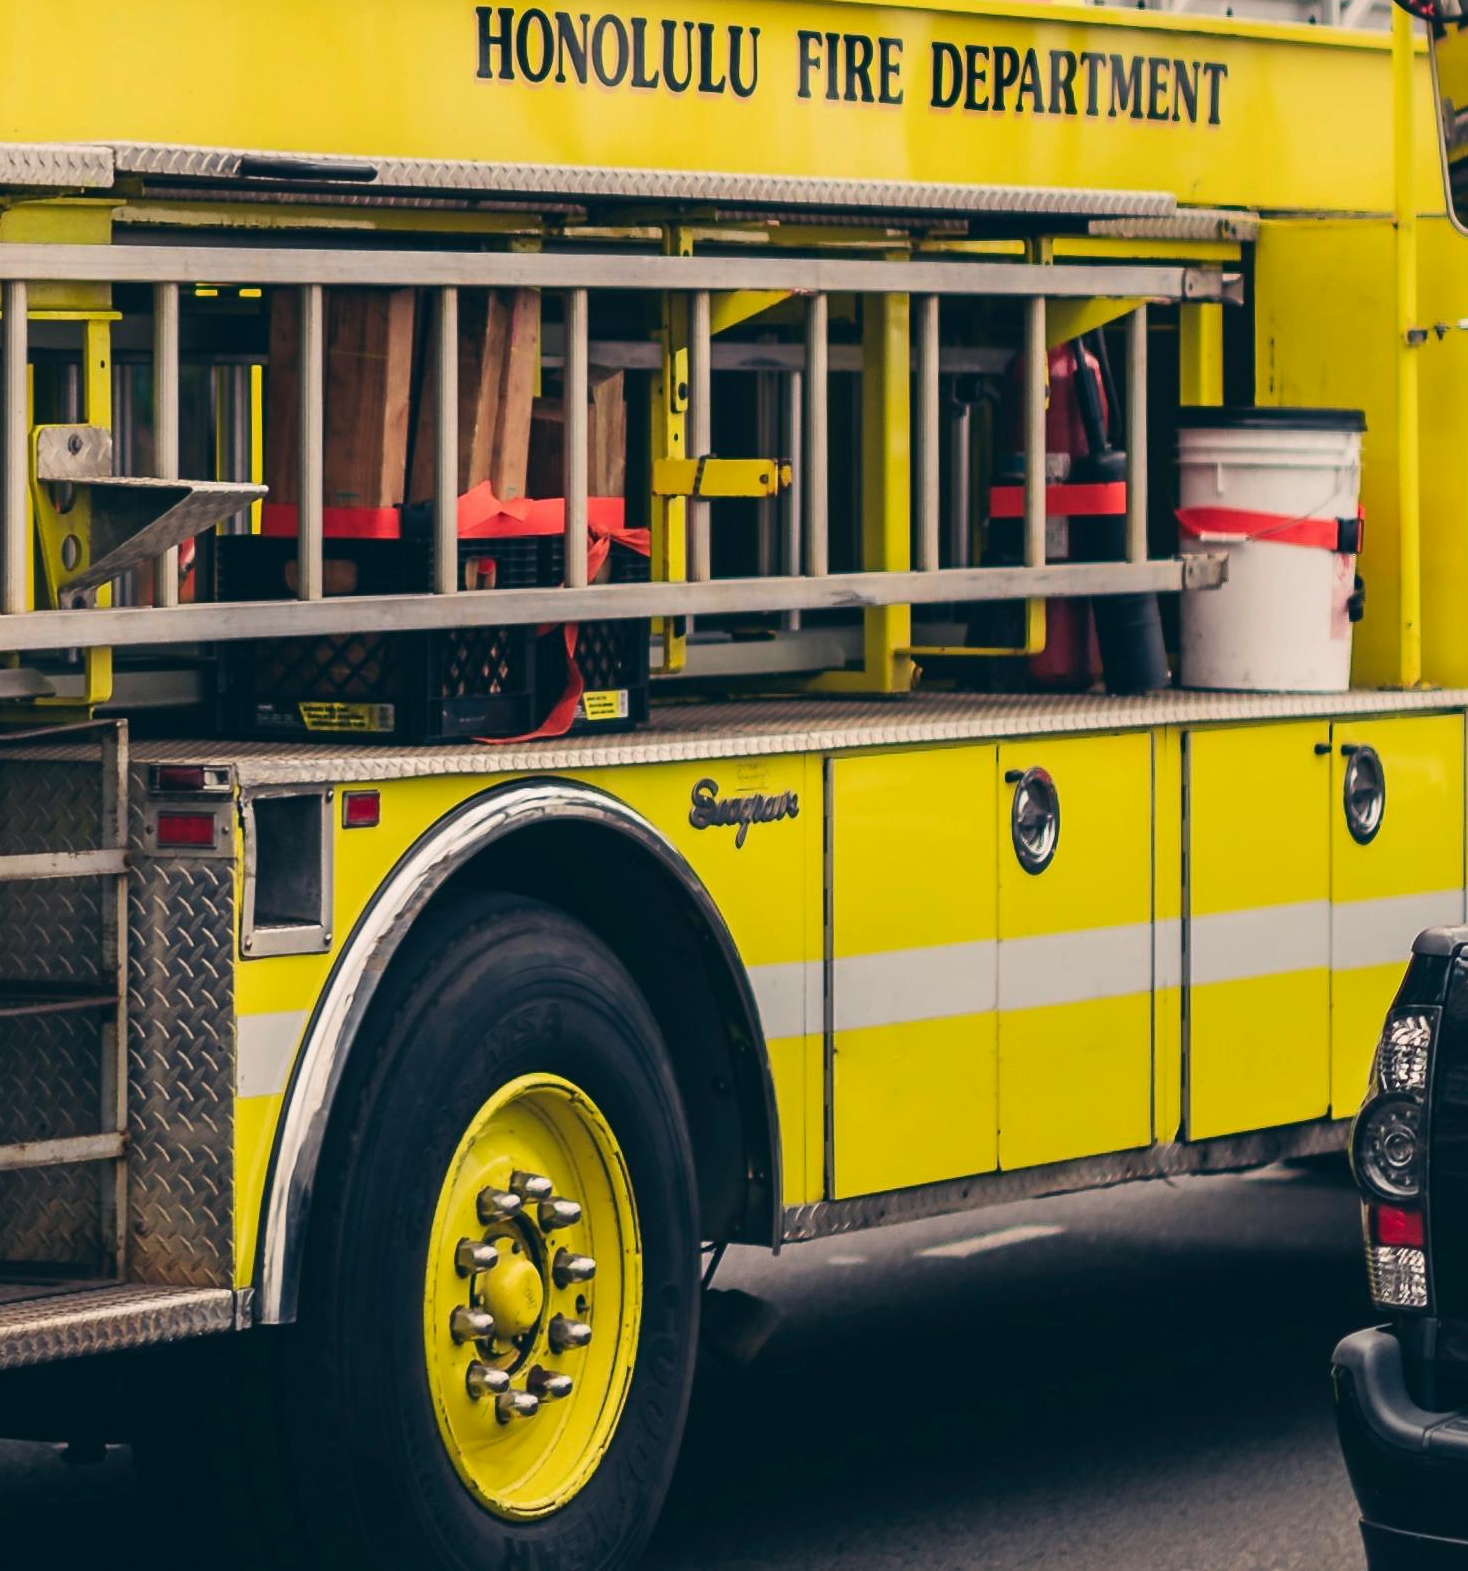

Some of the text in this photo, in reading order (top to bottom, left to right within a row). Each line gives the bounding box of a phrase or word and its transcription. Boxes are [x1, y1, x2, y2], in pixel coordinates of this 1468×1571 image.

[474, 6, 1229, 126] HONOLULU FIRE DEPARTMENT
